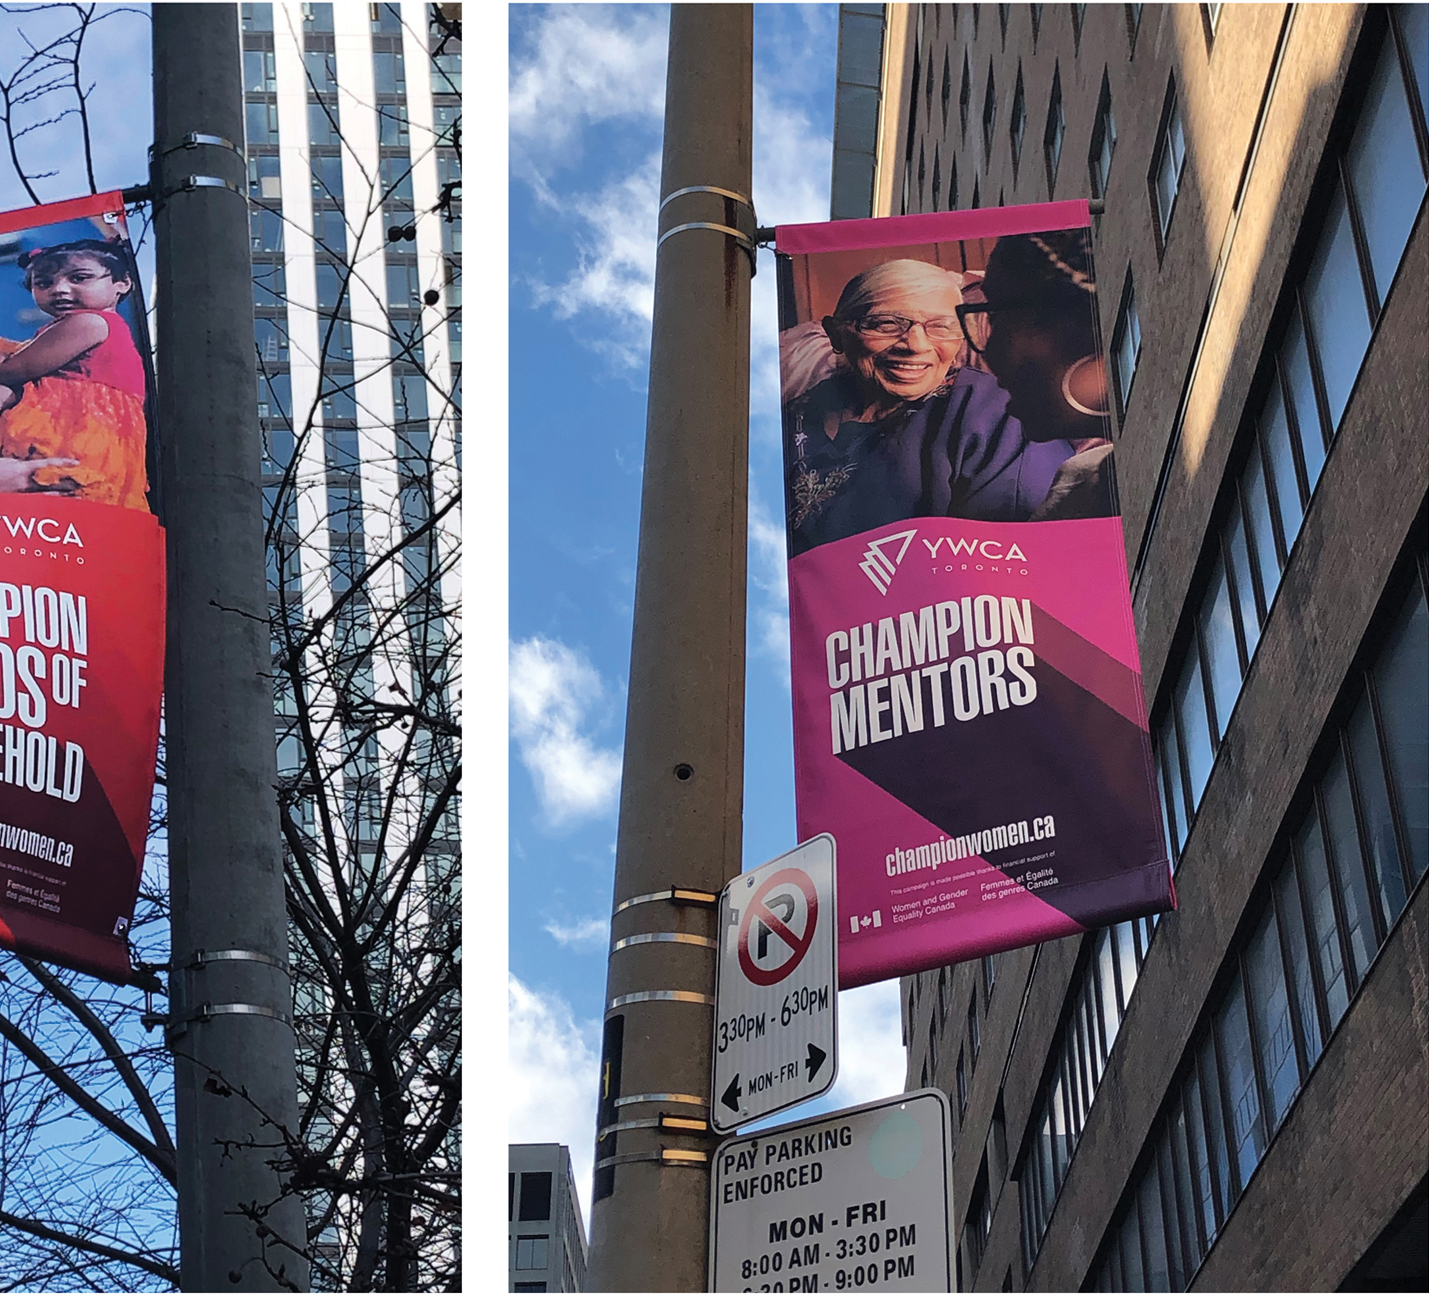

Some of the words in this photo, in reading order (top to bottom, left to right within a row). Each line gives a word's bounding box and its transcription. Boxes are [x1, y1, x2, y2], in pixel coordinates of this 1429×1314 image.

[922, 537, 1027, 562] YWCA
[931, 563, 1028, 576] TORONTO
[825, 594, 1034, 689] CHAMPION
[52, 654, 87, 708] OF
[830, 646, 1038, 755] MENTORS
[885, 815, 1056, 877] championwomen.ca
[903, 882, 929, 895] campaign
[936, 876, 952, 885] made
[952, 870, 976, 883] possible
[976, 866, 995, 875] thanks
[1002, 858, 1026, 869] financial
[1026, 852, 1049, 863] support
[980, 878, 1015, 892] Femmes
[1016, 875, 1024, 884] et
[1025, 867, 1054, 881] Égalité
[981, 891, 997, 901] des
[998, 885, 1025, 899] genres
[1026, 876, 1059, 890] Canada
[891, 901, 921, 914] Women
[922, 896, 937, 906] and
[939, 888, 969, 901] Gender
[893, 909, 923, 924] Equality
[924, 901, 956, 915] Canada
[748, 1060, 798, 1096] MON-FRI
[724, 1148, 758, 1175] PAY
[764, 1126, 852, 1165] PARKING
[723, 1162, 823, 1204] ENFORCED
[769, 1212, 824, 1243] MON
[846, 1200, 886, 1228] FRI
[741, 1252, 782, 1279] 8:00
[788, 1243, 820, 1270] AM
[836, 1232, 880, 1260] 3:30
[885, 1224, 916, 1250] PM
[789, 1274, 818, 1293] PM
[835, 1264, 878, 1290] 9:00
[884, 1255, 915, 1281] PM
